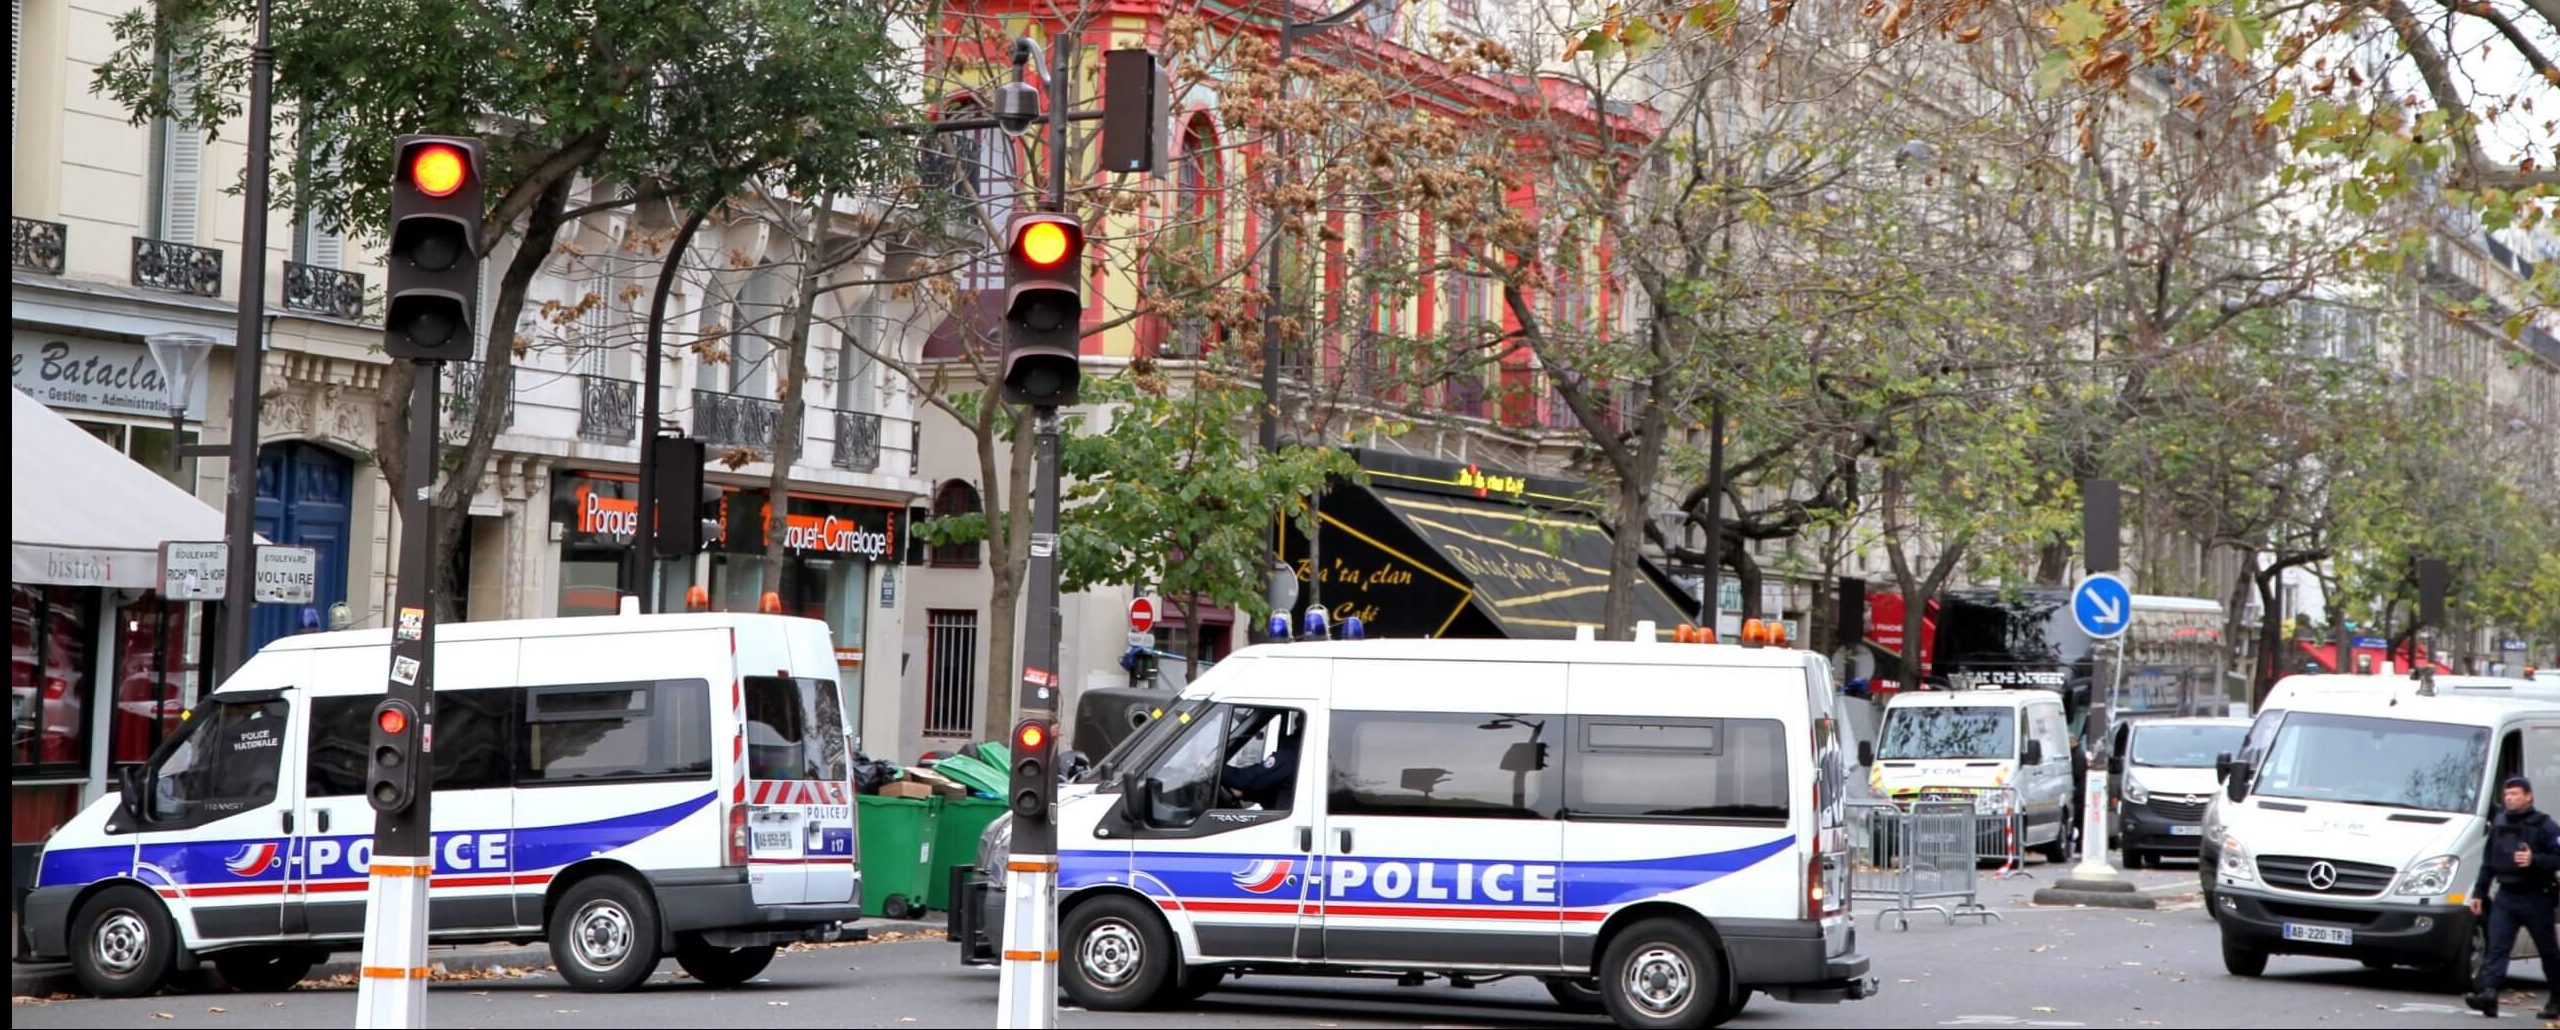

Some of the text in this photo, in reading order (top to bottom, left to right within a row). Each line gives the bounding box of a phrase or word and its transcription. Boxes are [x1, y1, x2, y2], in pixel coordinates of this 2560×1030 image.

[49, 387, 87, 403] Gestion
[101, 393, 169, 412] Administratio
[587, 492, 638, 543] Parque
[784, 514, 886, 562] rquet-Carrelage
[175, 551, 220, 560] BOULEVARD
[256, 571, 314, 586] VOLTAIRE
[240, 729, 270, 741] POLICE
[233, 738, 279, 751] NATIONALE
[807, 806, 840, 819] POLICE
[1208, 812, 1258, 822] TRANSIT
[1329, 860, 1558, 903] POLICE
